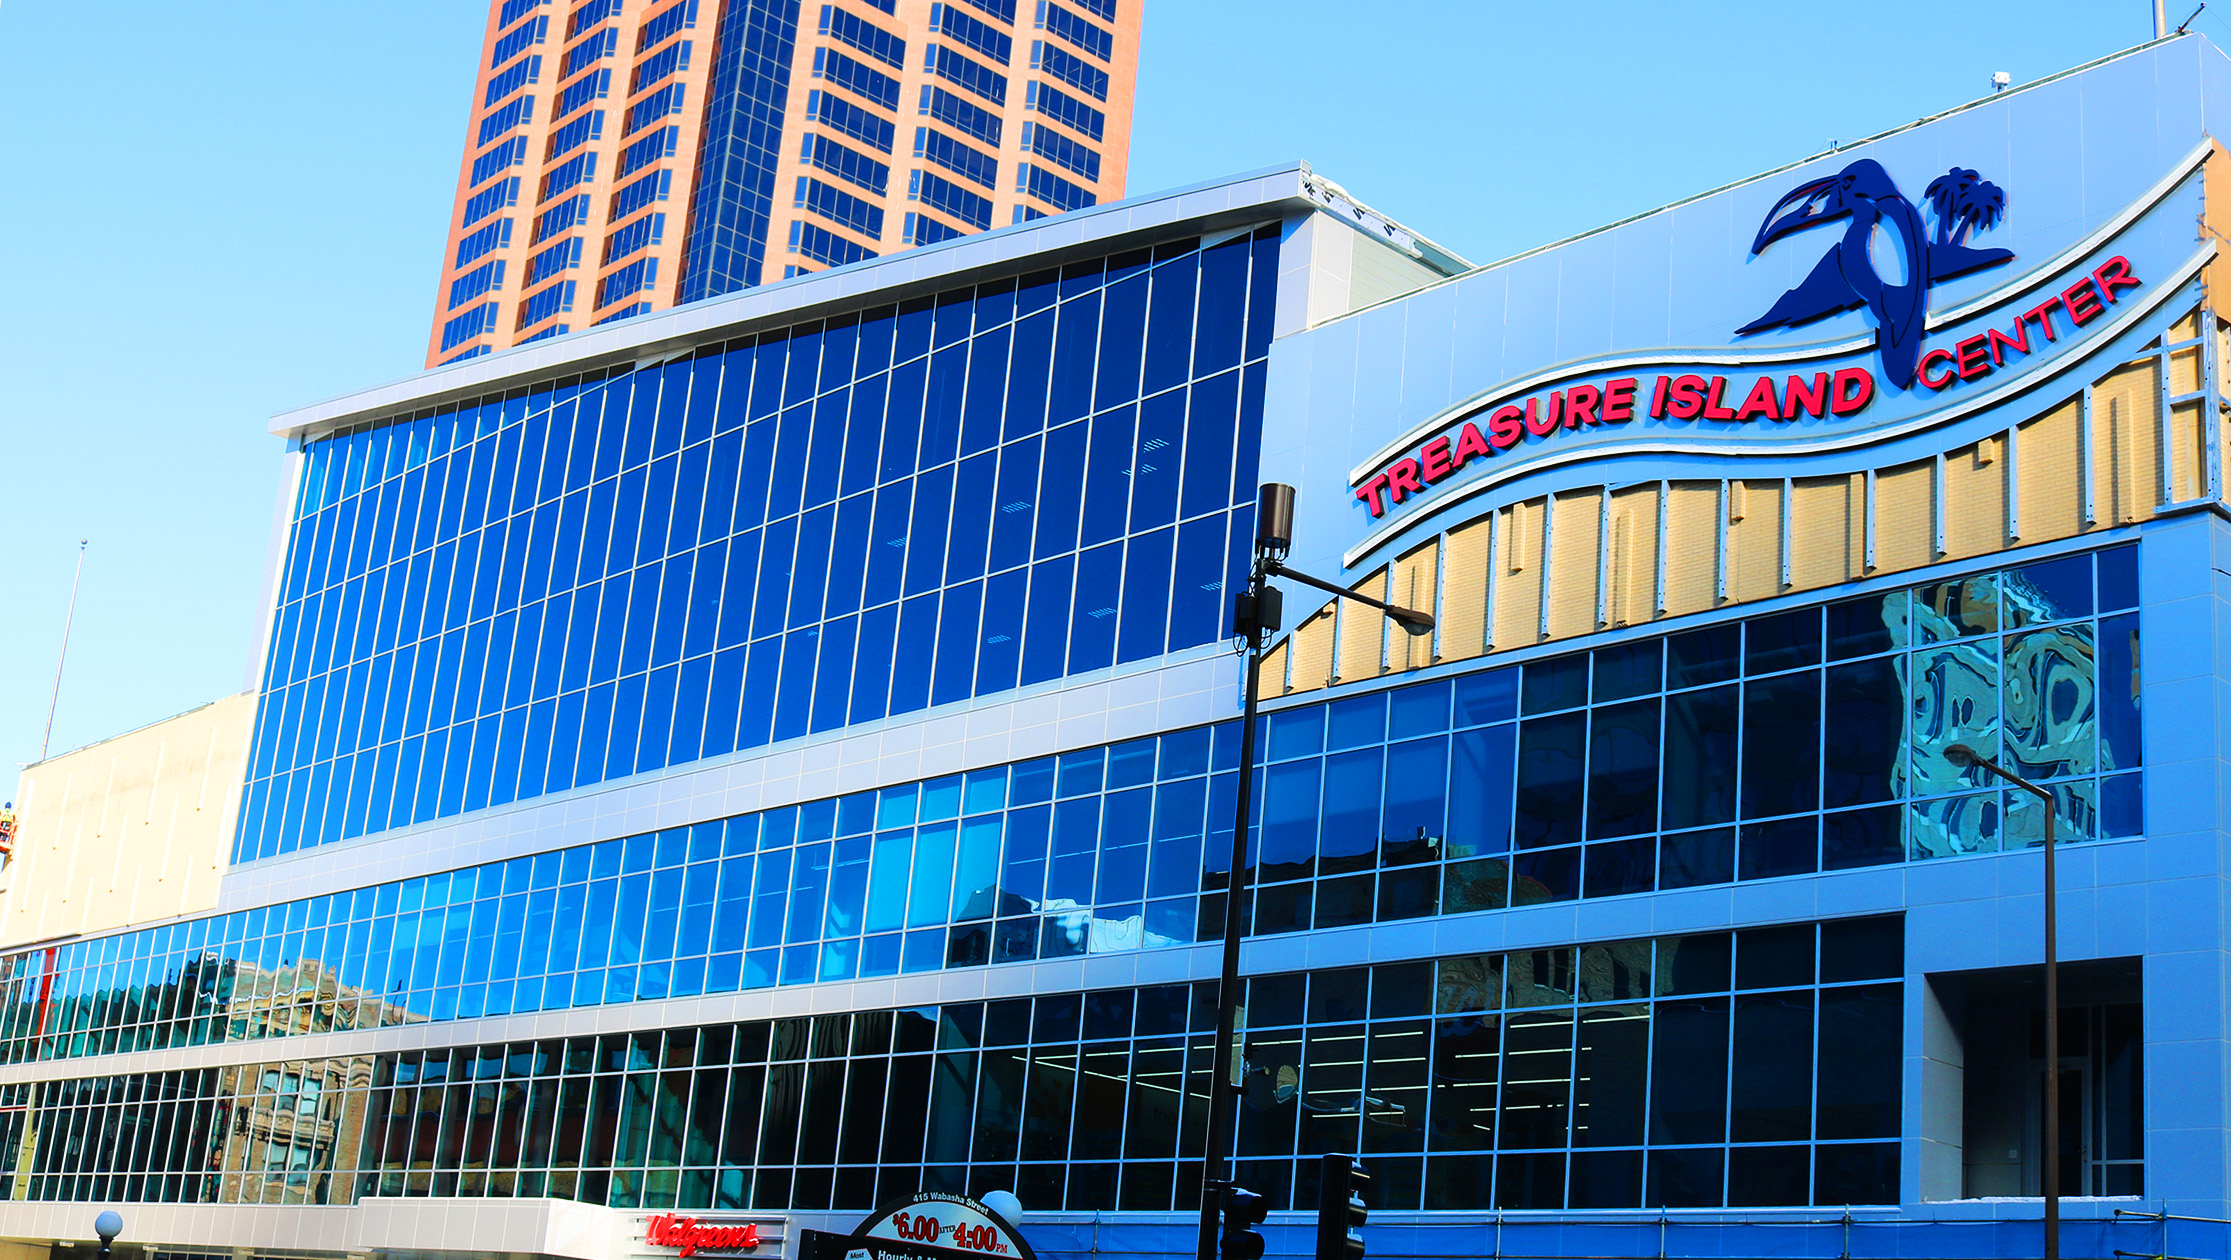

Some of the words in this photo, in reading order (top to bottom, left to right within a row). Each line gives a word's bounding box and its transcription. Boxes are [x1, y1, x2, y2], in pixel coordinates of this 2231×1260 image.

[1355, 376, 1636, 518] TREASURE
[1649, 367, 1874, 420] ISLAND
[1917, 255, 2140, 390] CENTER
[913, 1193, 928, 1203] 415
[930, 1191, 964, 1204] Wabasha
[965, 1198, 989, 1215] Street
[645, 1212, 759, 1258] Walgreens
[892, 1211, 939, 1243] $6.00
[953, 1222, 997, 1251] 4:00
[996, 1243, 1008, 1254] PM
